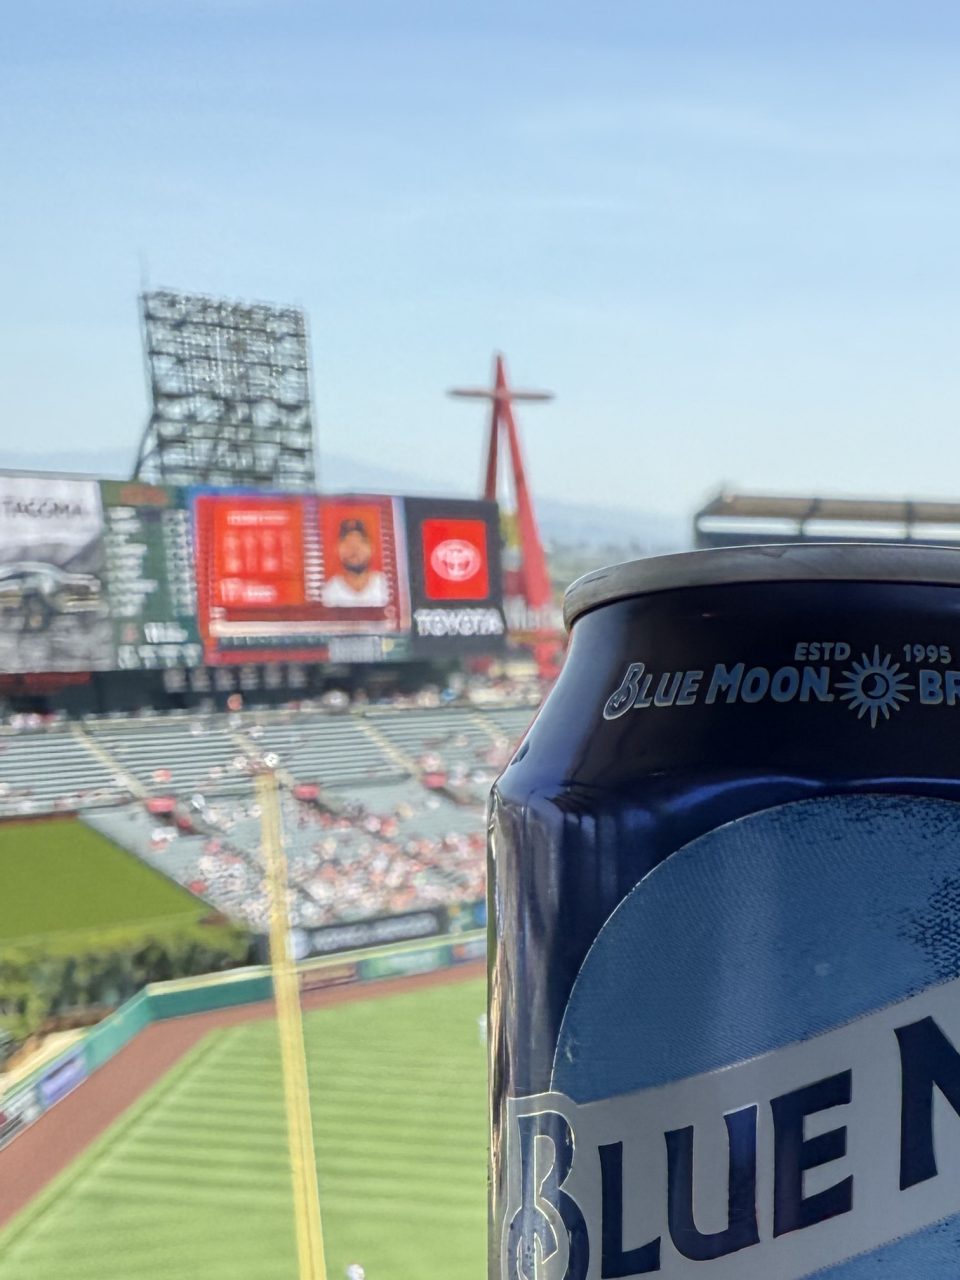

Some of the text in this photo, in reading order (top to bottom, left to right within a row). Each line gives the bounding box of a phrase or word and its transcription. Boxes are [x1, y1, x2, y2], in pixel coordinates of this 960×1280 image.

[414, 608, 504, 636] TOYOTA
[795, 642, 952, 664] ESTD 1995
[603, 662, 704, 720] BLUE
[705, 663, 834, 704] MOON
